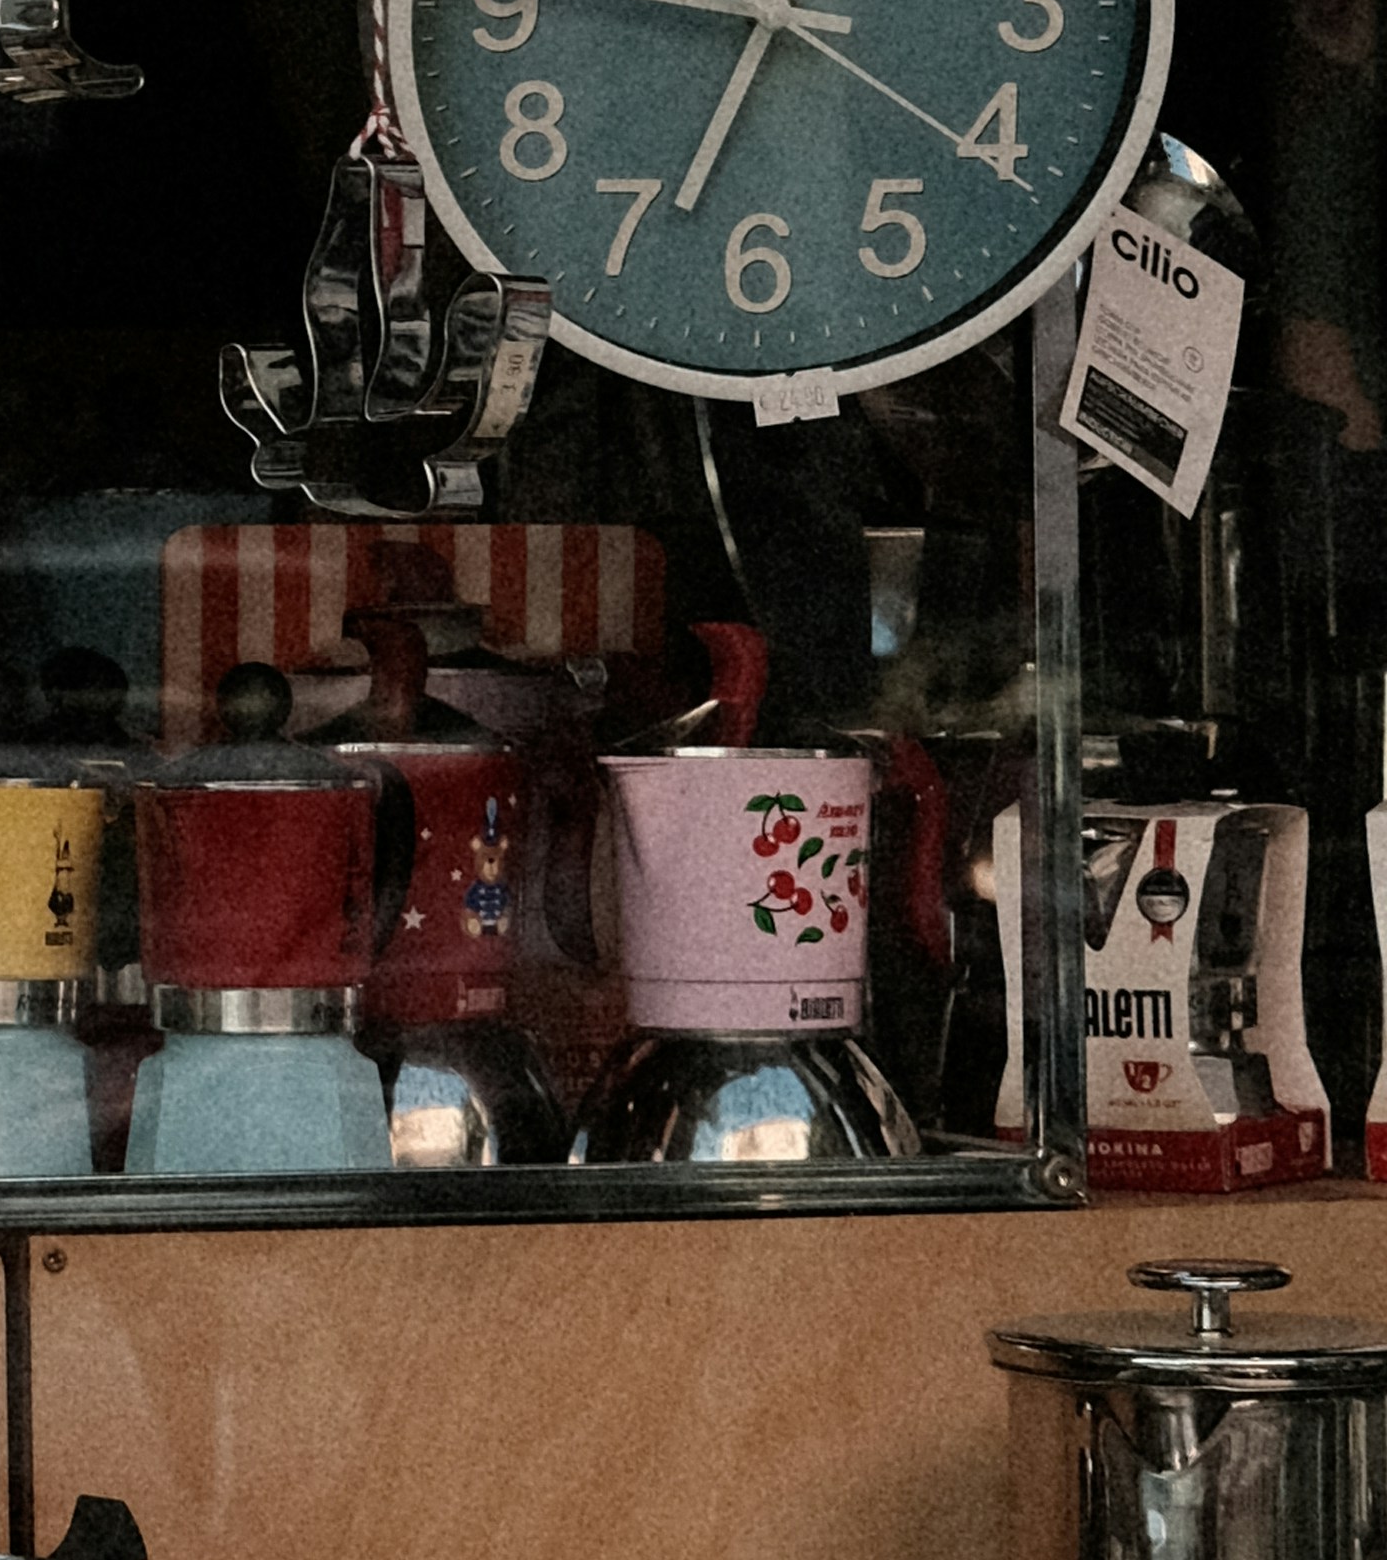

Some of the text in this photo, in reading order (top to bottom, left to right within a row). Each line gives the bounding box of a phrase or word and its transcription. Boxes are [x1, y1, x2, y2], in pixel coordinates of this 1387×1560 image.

[499, 80, 568, 181] 8
[957, 82, 1027, 181] 4
[595, 178, 662, 276] 7
[724, 213, 792, 314] 6
[858, 177, 926, 278] 5
[1112, 229, 1200, 300] cilio
[1085, 987, 1173, 1039] ALETTI
